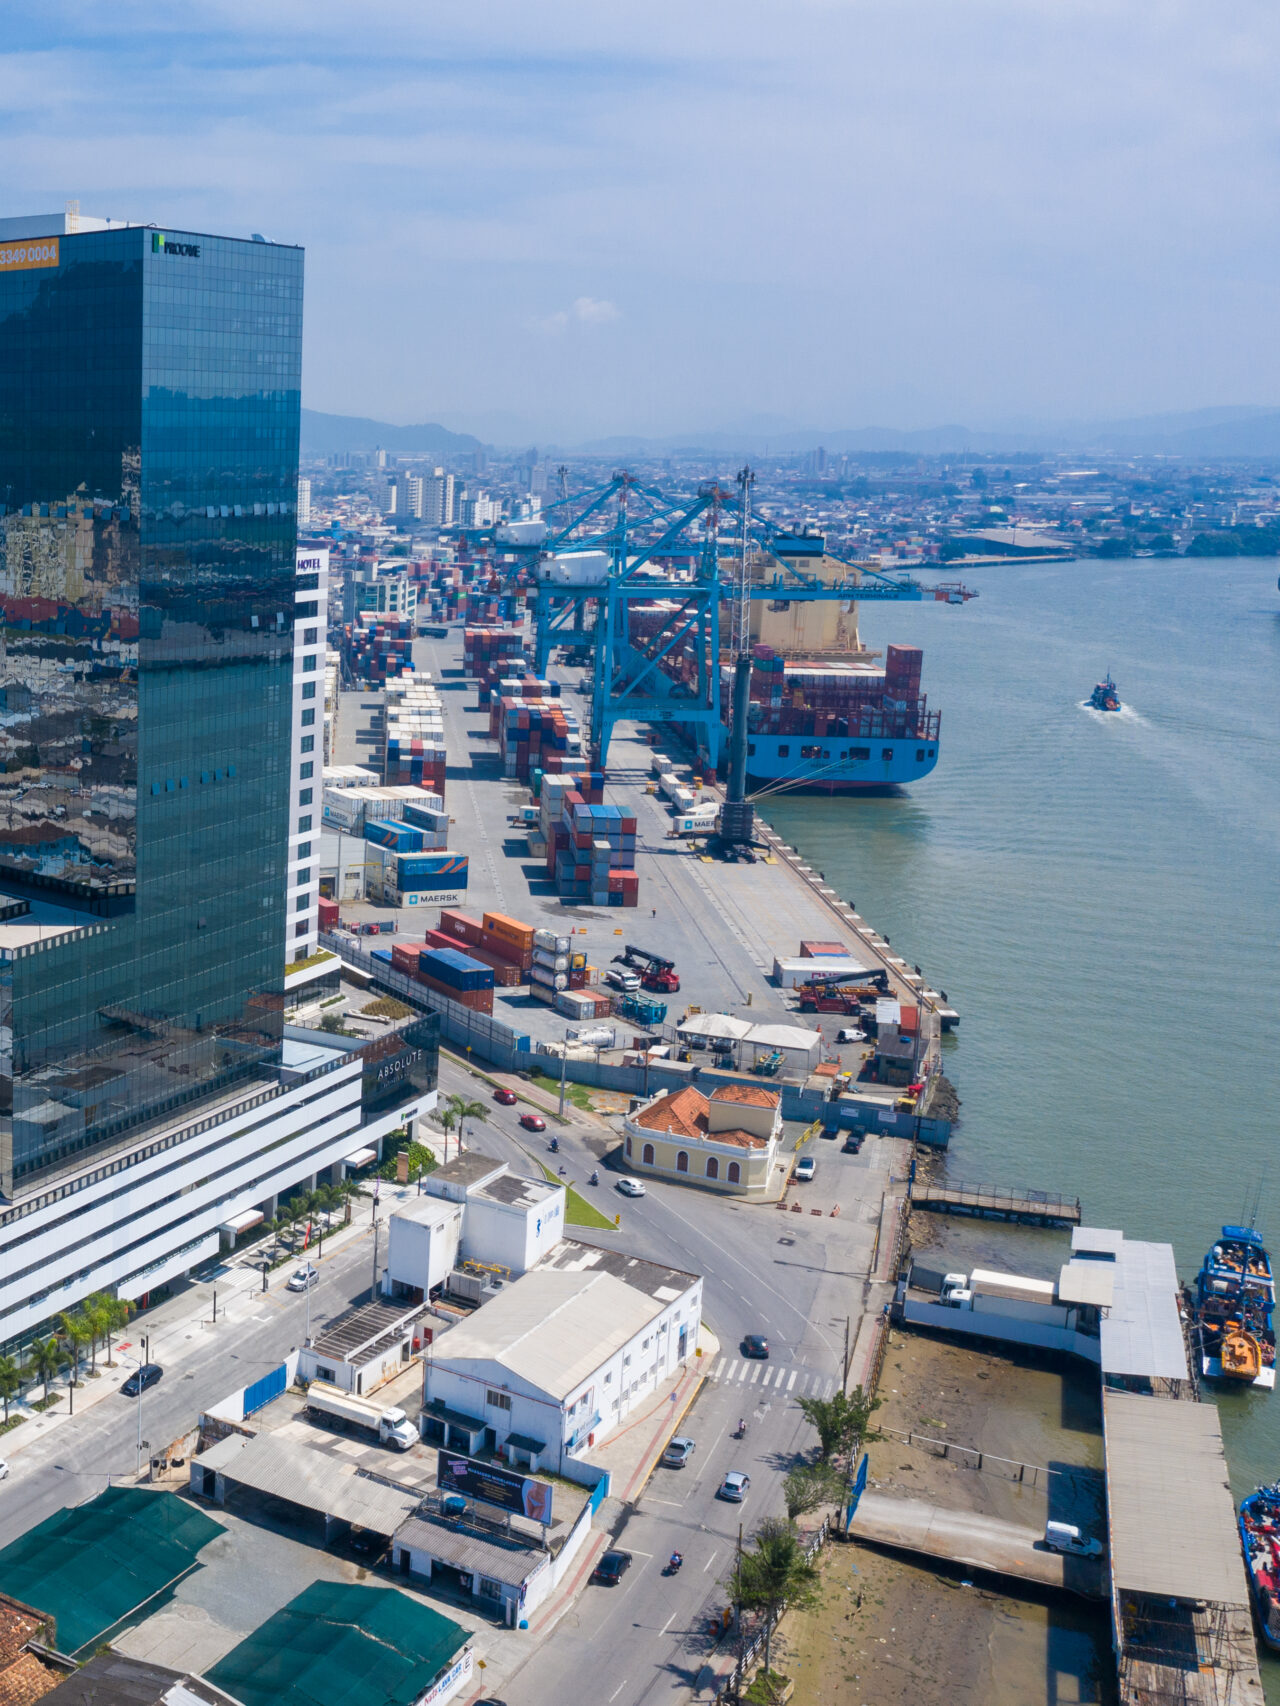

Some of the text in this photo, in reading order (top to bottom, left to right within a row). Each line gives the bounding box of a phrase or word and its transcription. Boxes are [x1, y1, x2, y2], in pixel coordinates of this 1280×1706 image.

[0, 250, 26, 265] 3349
[27, 245, 57, 262] 0004
[297, 558, 320, 569] HOTEL
[420, 894, 458, 903] MAERSK
[378, 1049, 422, 1080] ABSOLUTE
